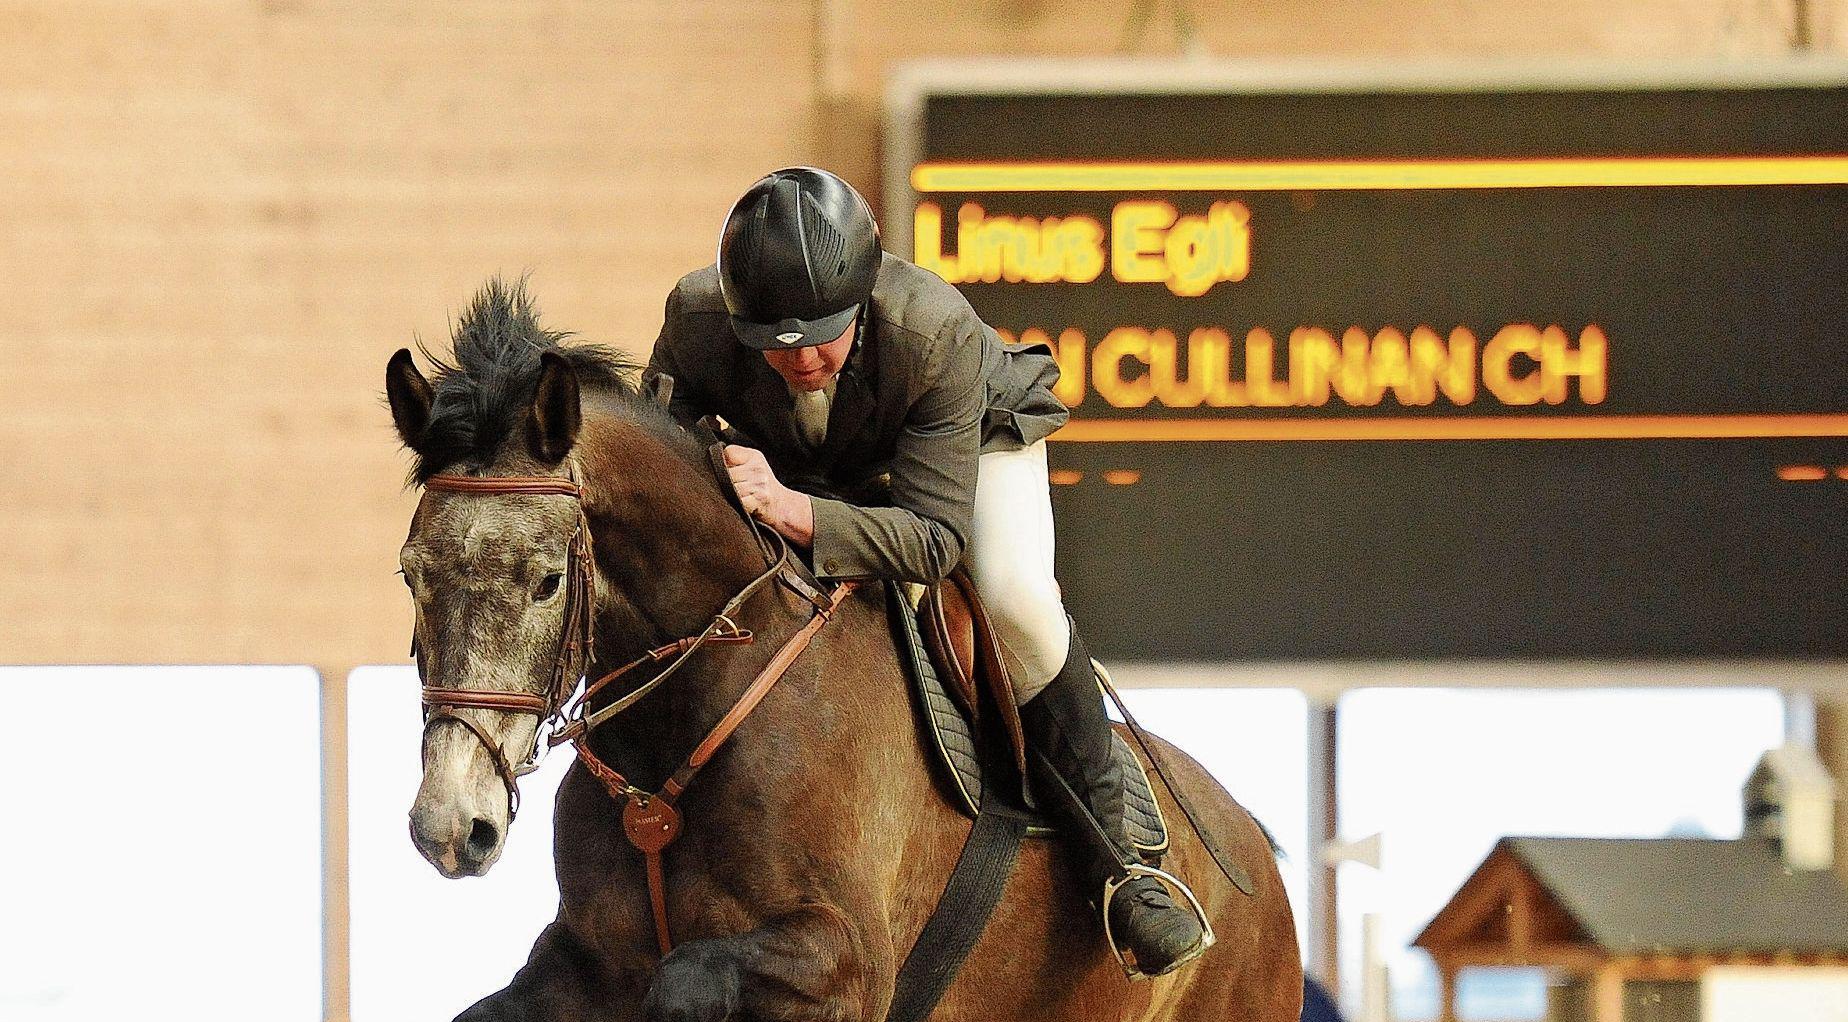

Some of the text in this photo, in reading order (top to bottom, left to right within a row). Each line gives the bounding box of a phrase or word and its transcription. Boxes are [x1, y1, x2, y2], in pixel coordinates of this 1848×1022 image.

[914, 200, 1252, 297] Linus Egli
[1091, 325, 1477, 408] CULLINAN
[1482, 323, 1608, 405] CH
